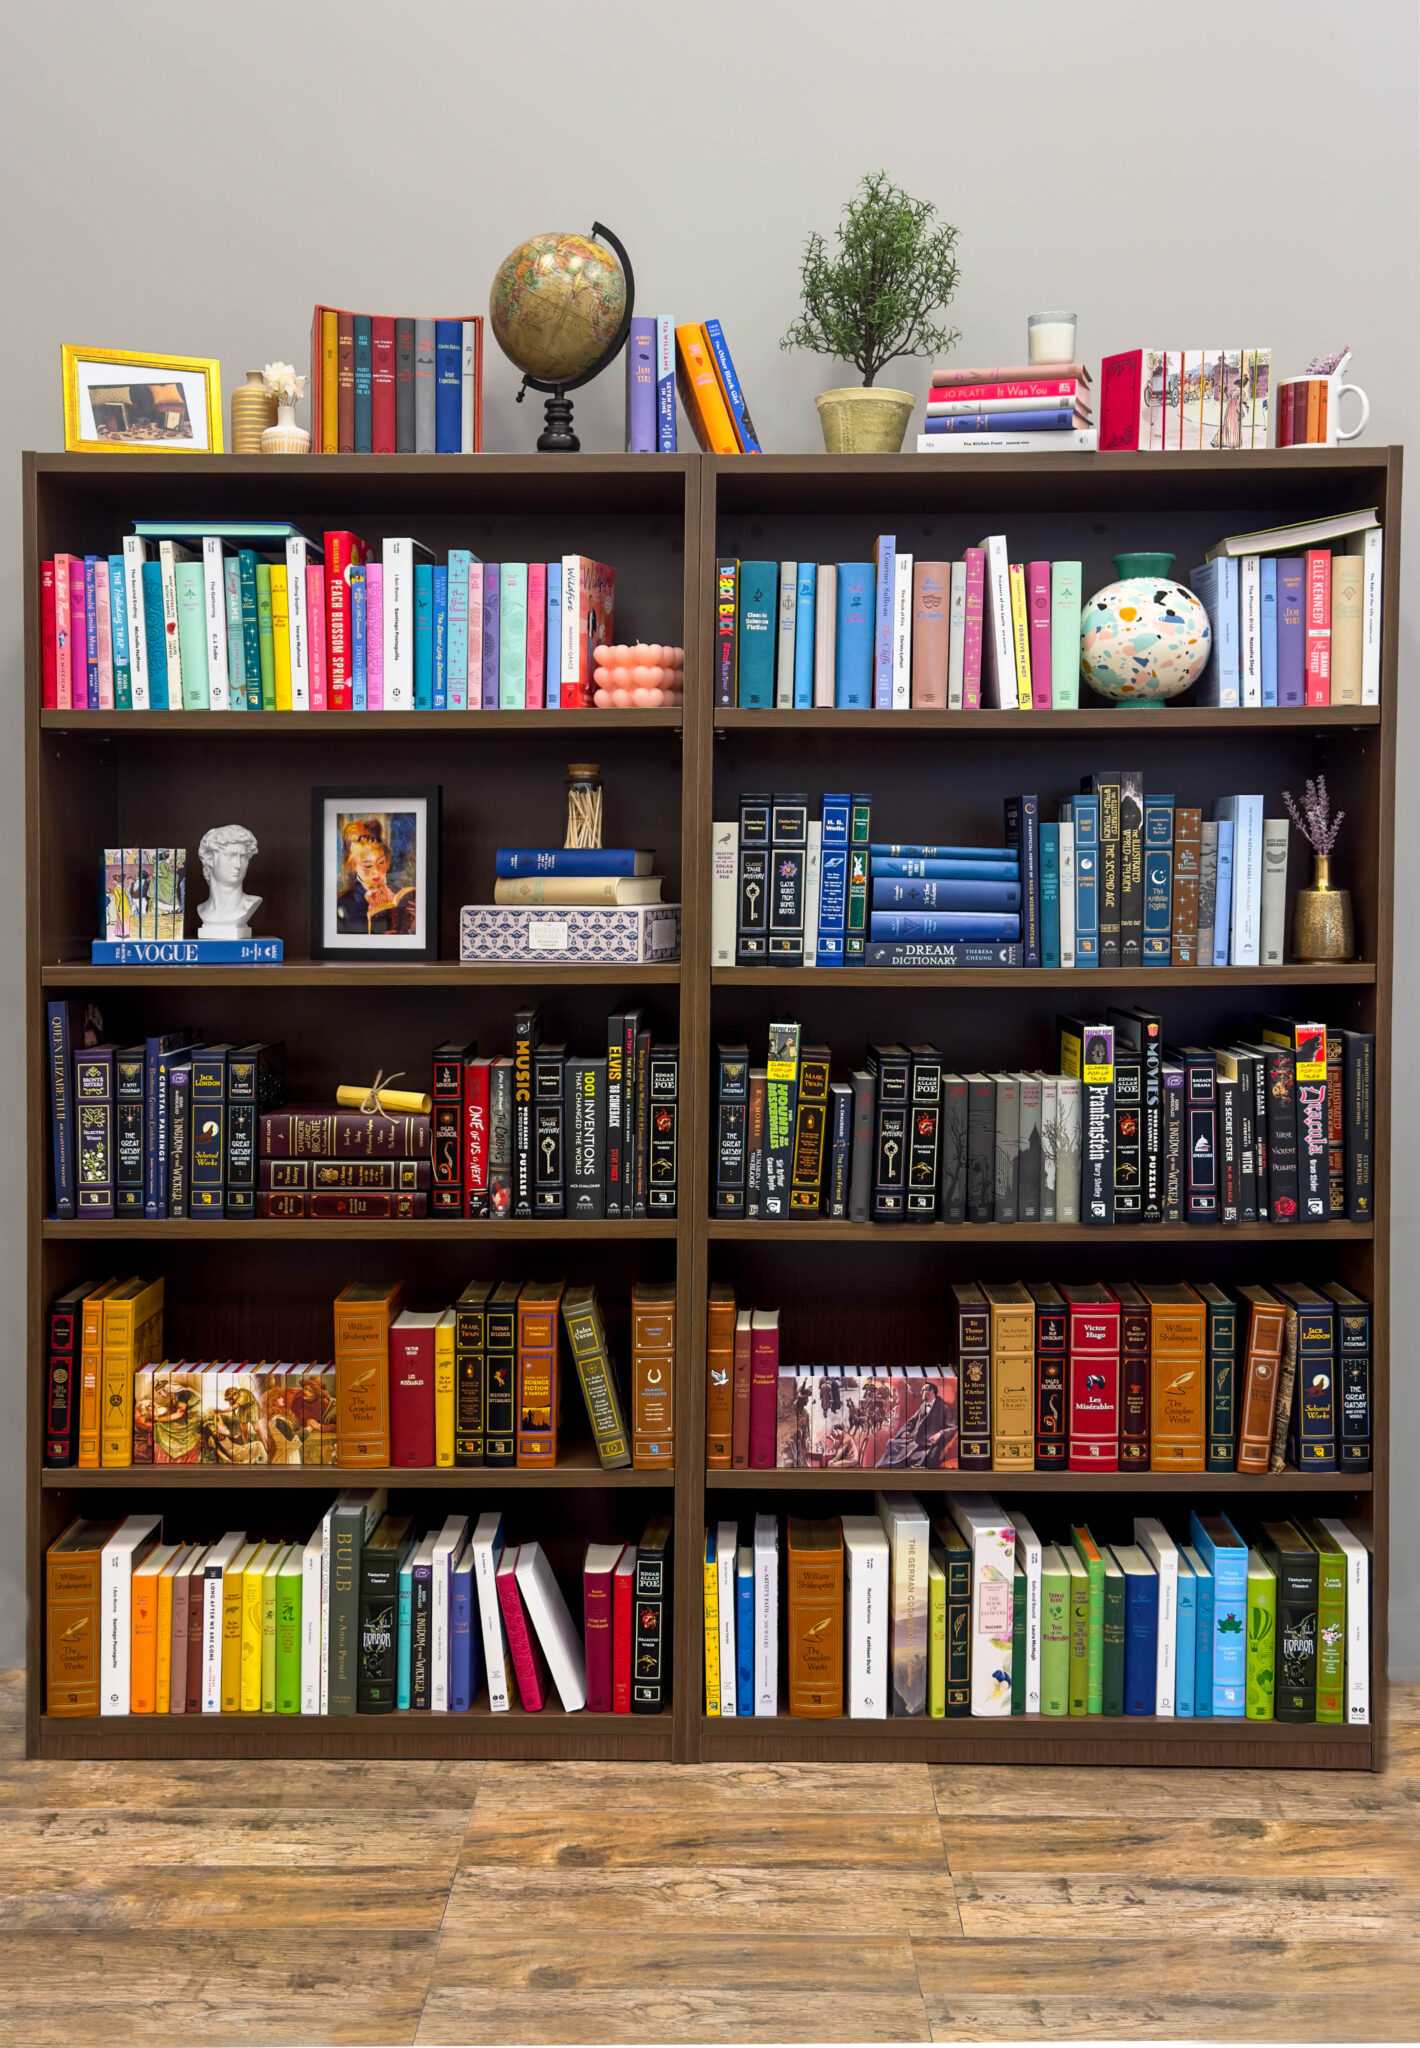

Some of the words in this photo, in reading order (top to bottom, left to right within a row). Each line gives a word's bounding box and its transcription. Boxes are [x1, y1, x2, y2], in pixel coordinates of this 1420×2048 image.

[725, 371, 735, 390] Black
[731, 390, 739, 404] Girl
[944, 391, 956, 399] JO
[959, 389, 984, 397] PLATT
[997, 388, 1003, 396] It
[1007, 387, 1028, 396] Was
[1030, 385, 1047, 395] You
[114, 572, 122, 584] THE
[883, 553, 891, 585] Courtney
[1313, 560, 1324, 580] ELLE
[331, 580, 342, 608] PEACH
[567, 568, 575, 612] Wildfire
[113, 588, 124, 624] Holiday
[231, 595, 239, 620] GAME
[1313, 582, 1323, 624] KENNEDY
[116, 628, 124, 648] TRAP
[332, 612, 343, 653] BLOSSOM
[881, 643, 890, 665] Cliffs
[1020, 655, 1026, 664] ME
[1311, 652, 1319, 672] EFFECT
[1320, 652, 1328, 677] GRAHAM
[333, 658, 344, 689] SPRING
[1105, 844, 1115, 858] THE
[1123, 830, 1131, 854] WORLD
[1132, 839, 1140, 882] ILLUSTRATED
[1105, 860, 1115, 890] SECOND
[1122, 863, 1131, 892] TOLKIEN
[1105, 892, 1115, 907] AGE
[134, 944, 198, 961] VOGUE
[892, 957, 957, 965] DICTIONARY
[906, 945, 954, 955] DREAM
[52, 1017, 63, 1052] QUEEN
[516, 1041, 530, 1102] MUSIC
[609, 1047, 621, 1079] ELVIS
[1147, 1043, 1158, 1105] MOVIES
[54, 1055, 65, 1109] ELIZABETH
[585, 1071, 595, 1097] 1001
[57, 1111, 66, 1119] II
[470, 1106, 483, 1130] ONE
[609, 1095, 619, 1127] COMEBACK
[768, 1083, 779, 1149] BASKERVILLES
[778, 1084, 788, 1135] HOUND
[1299, 1085, 1327, 1155] Dracula
[1088, 1085, 1110, 1160] Frankenstein
[471, 1131, 480, 1140] OF
[584, 1099, 594, 1175] INVENTIONS
[471, 1142, 481, 1154] US
[1225, 1137, 1233, 1161] SISTER
[471, 1163, 481, 1185] NEXT
[519, 1153, 527, 1195] PUZZLES
[767, 1157, 775, 1174] Conan
[1093, 1163, 1101, 1176] Mary
[1242, 1151, 1253, 1173] WITCH
[1310, 1160, 1318, 1173] Bram
[767, 1176, 776, 1190] Doyle
[1094, 1178, 1102, 1197] Shelley
[575, 1332, 594, 1340] Verne
[336, 1533, 352, 1592] BULB
[907, 1557, 915, 1592] GERMAN
[339, 1624, 347, 1646] Anna
[1284, 1639, 1313, 1654] HORROR
